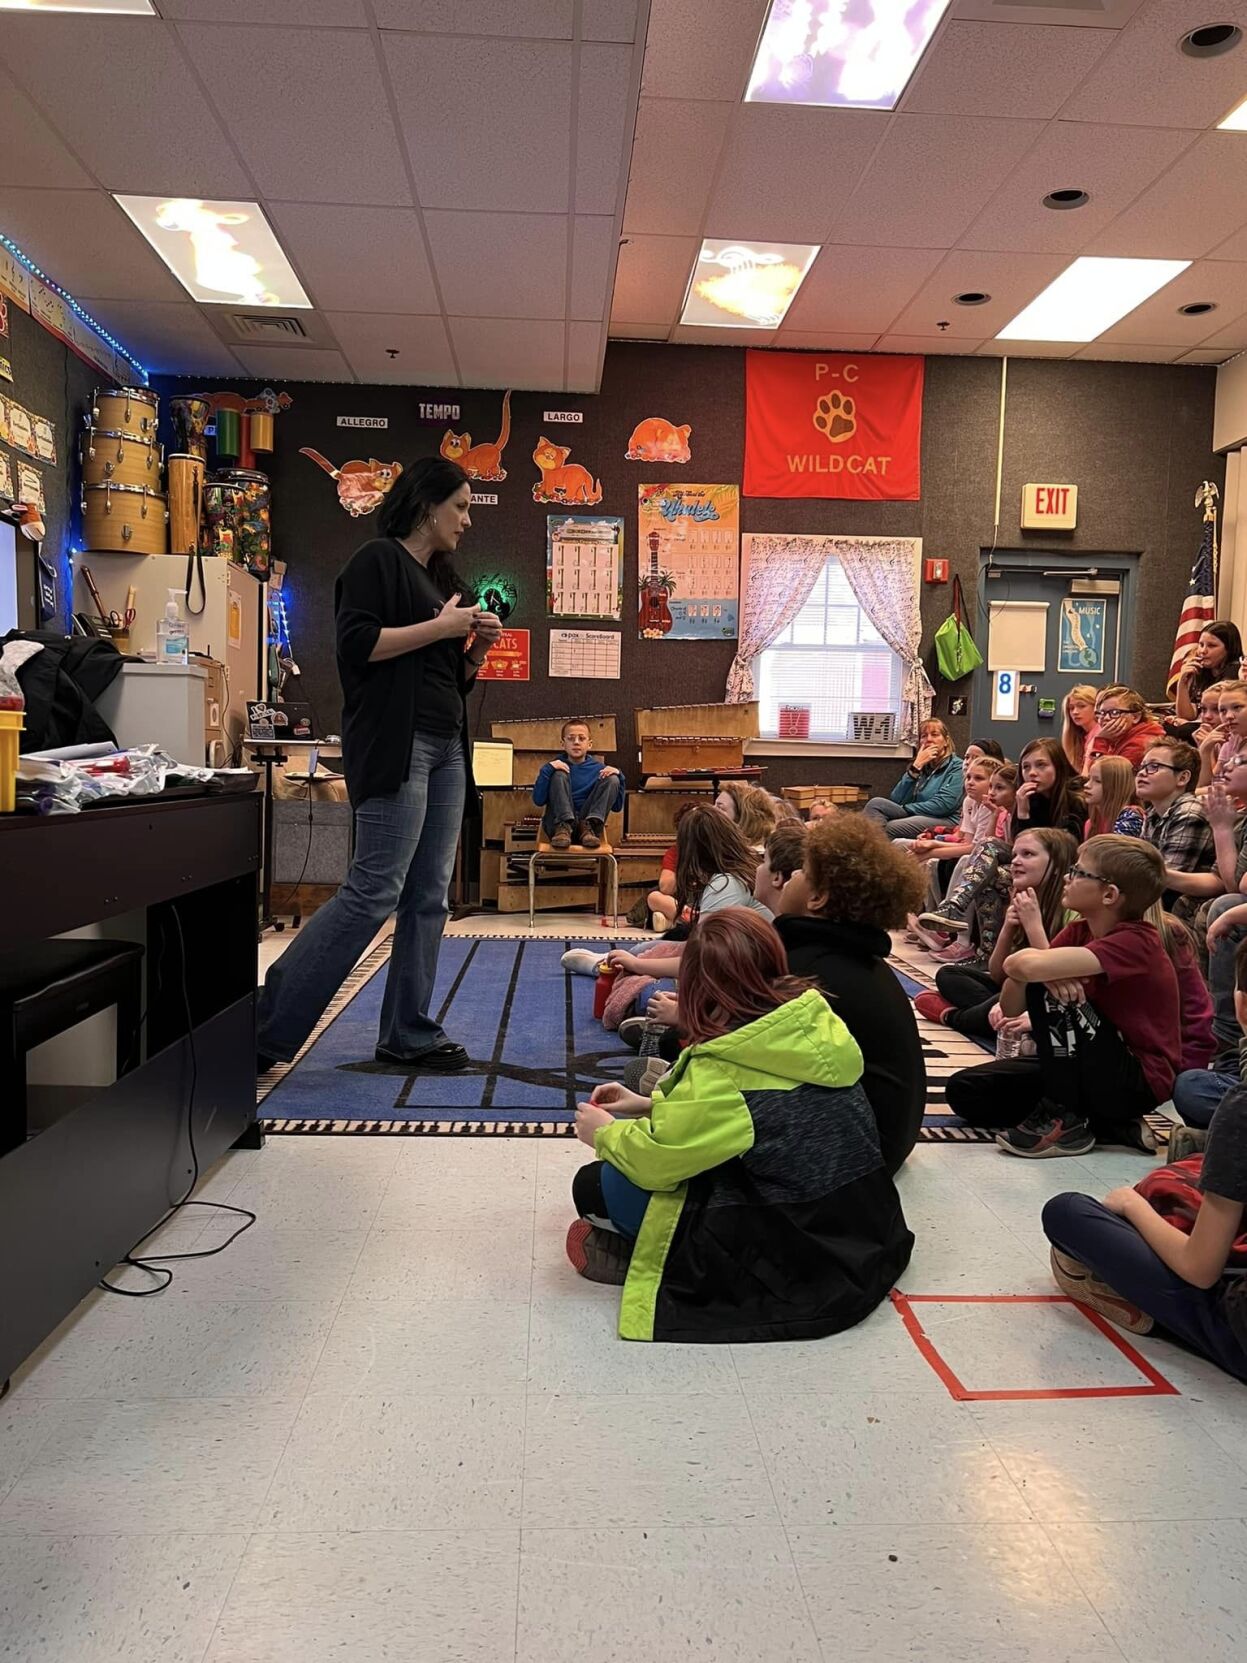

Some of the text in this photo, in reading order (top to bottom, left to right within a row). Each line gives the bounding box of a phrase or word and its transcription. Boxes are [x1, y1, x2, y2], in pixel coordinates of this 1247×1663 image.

[418, 403, 460, 420] TEMPO
[547, 413, 580, 421] LARGO
[340, 417, 387, 428] ALLEGRO
[787, 454, 892, 475] WILDCAT
[471, 495, 497, 504] ANTE
[1035, 488, 1070, 515] EXIT
[1078, 607, 1101, 615] MUSIC
[998, 673, 1012, 694] 8
